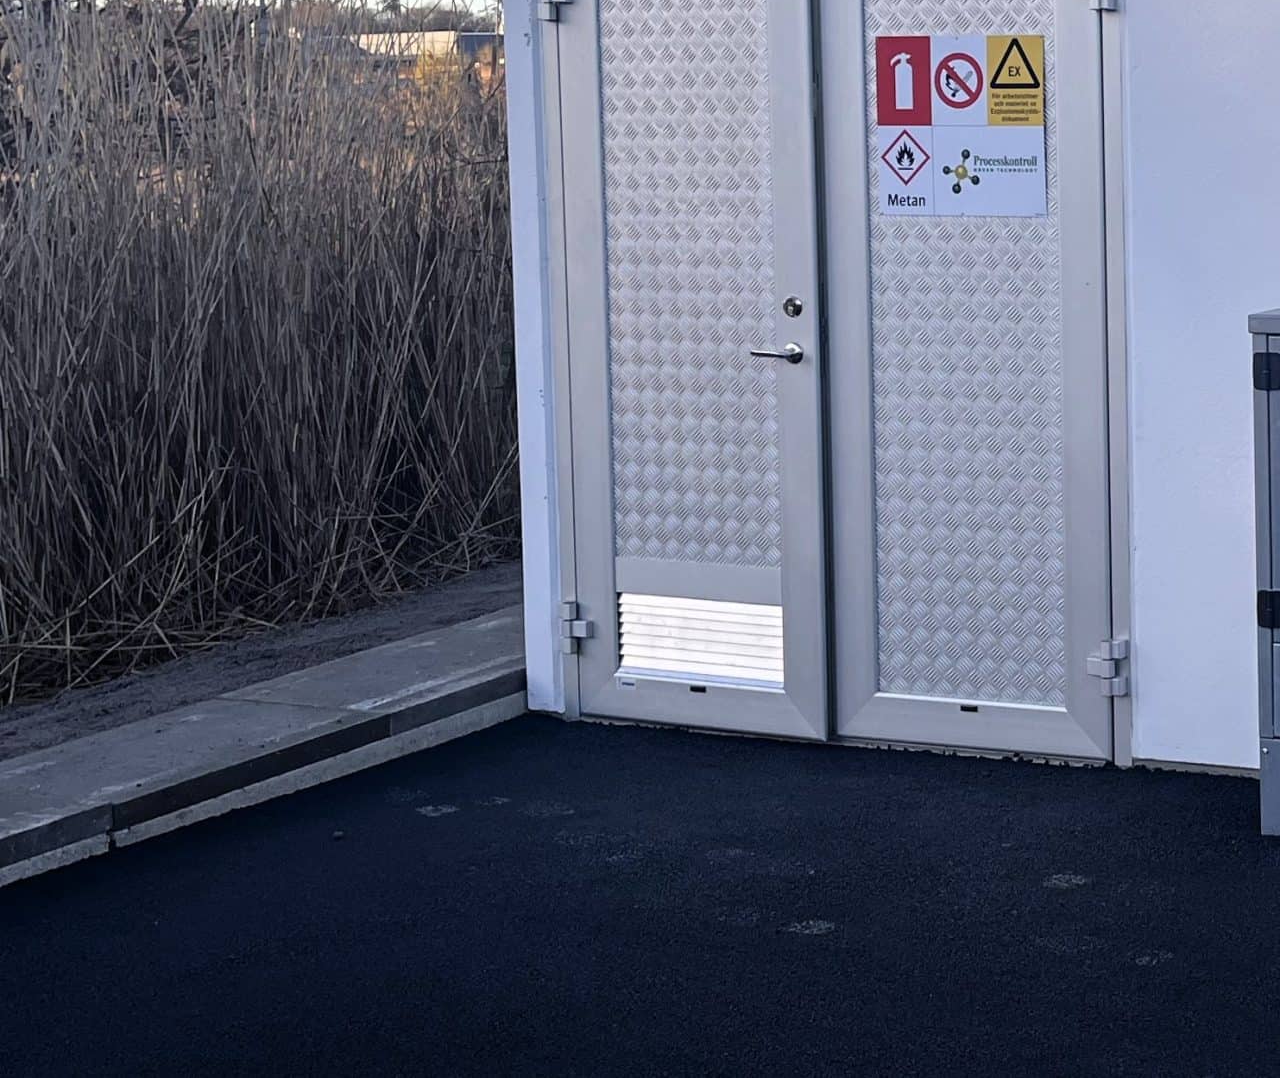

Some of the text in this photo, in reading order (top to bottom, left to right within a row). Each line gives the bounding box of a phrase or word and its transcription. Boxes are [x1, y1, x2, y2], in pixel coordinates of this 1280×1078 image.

[1008, 66, 1021, 77] EX
[973, 155, 1038, 167] Processkontroll
[887, 193, 926, 207] Metan
